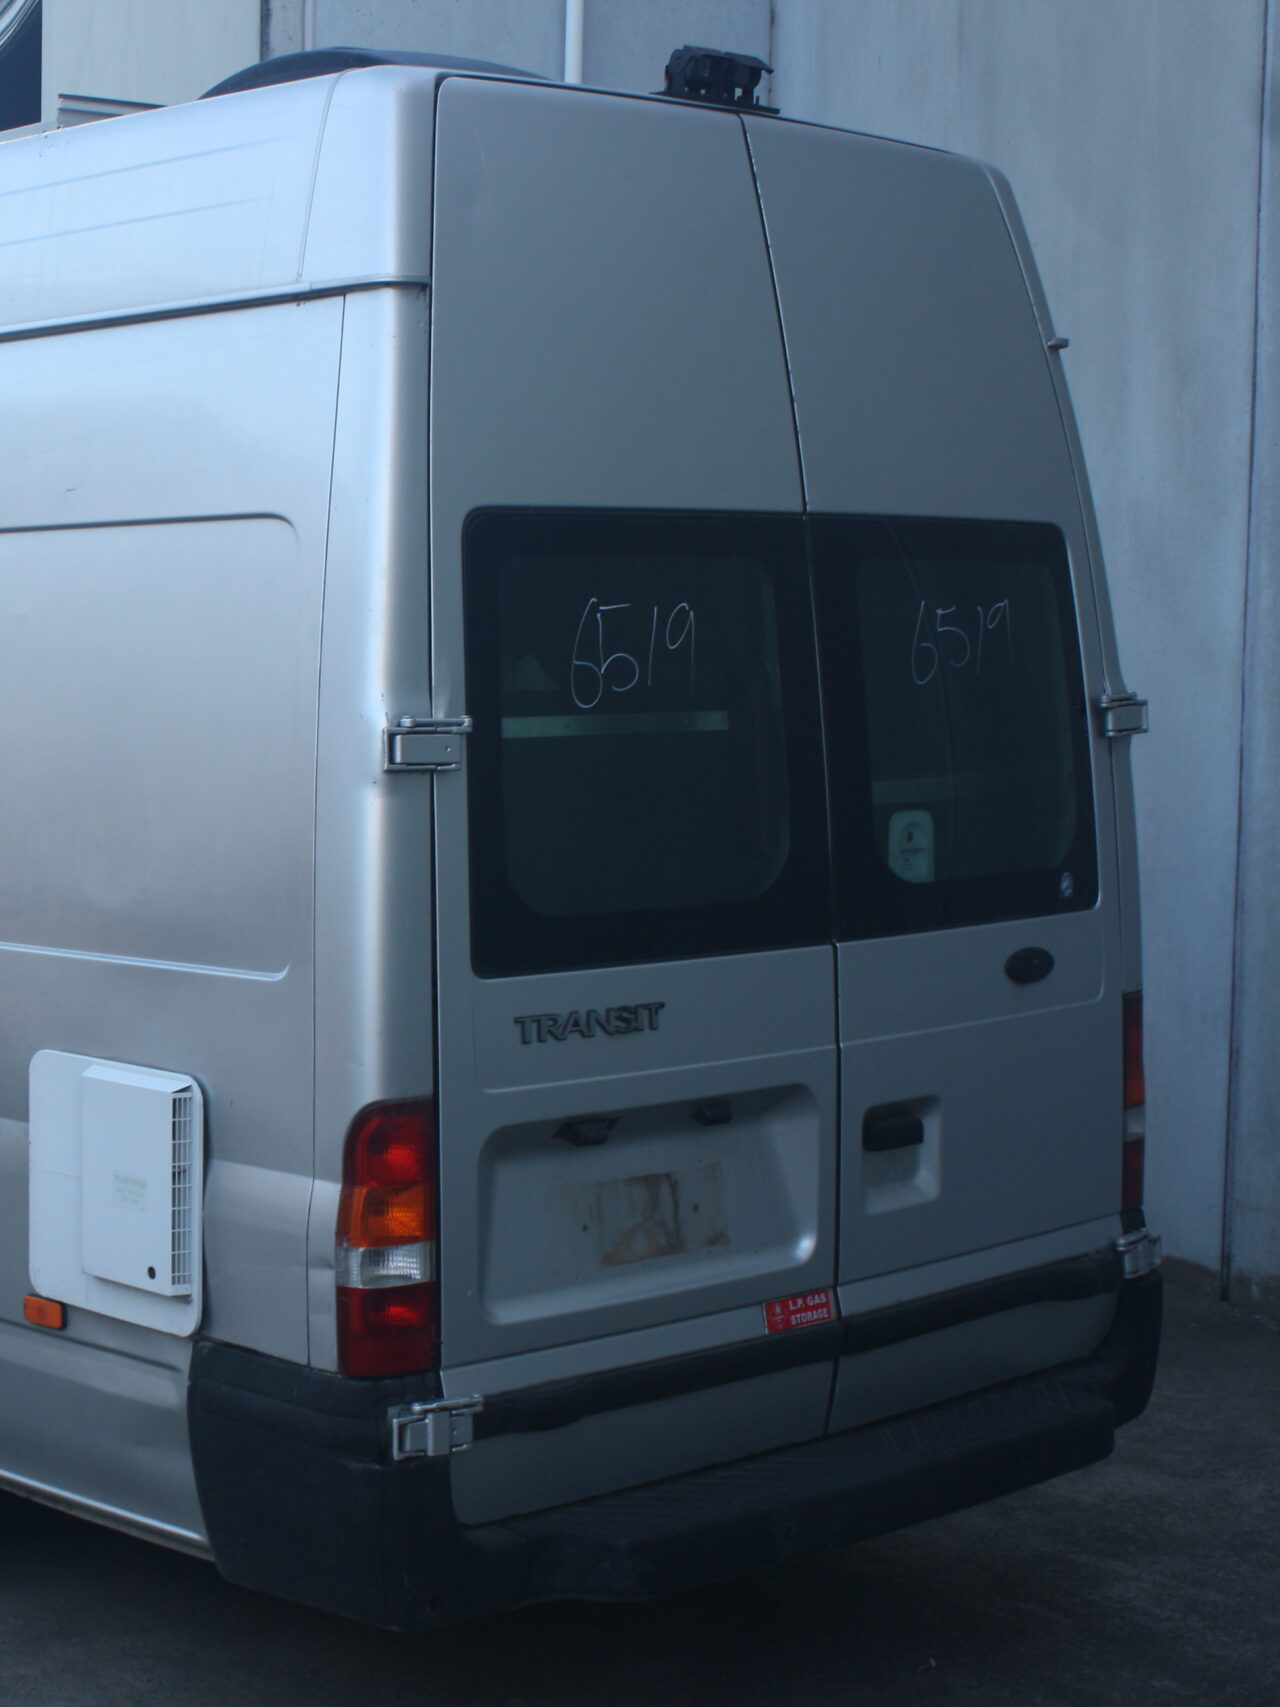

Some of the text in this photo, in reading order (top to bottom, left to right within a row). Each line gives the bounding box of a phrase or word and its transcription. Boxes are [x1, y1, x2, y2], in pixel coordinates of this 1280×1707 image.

[570, 597, 695, 708] 6519
[910, 599, 1012, 684] 6519
[513, 1001, 665, 1045] TRANSIT
[790, 1308, 829, 1325] STORAGE
[807, 1293, 826, 1305] GAS
